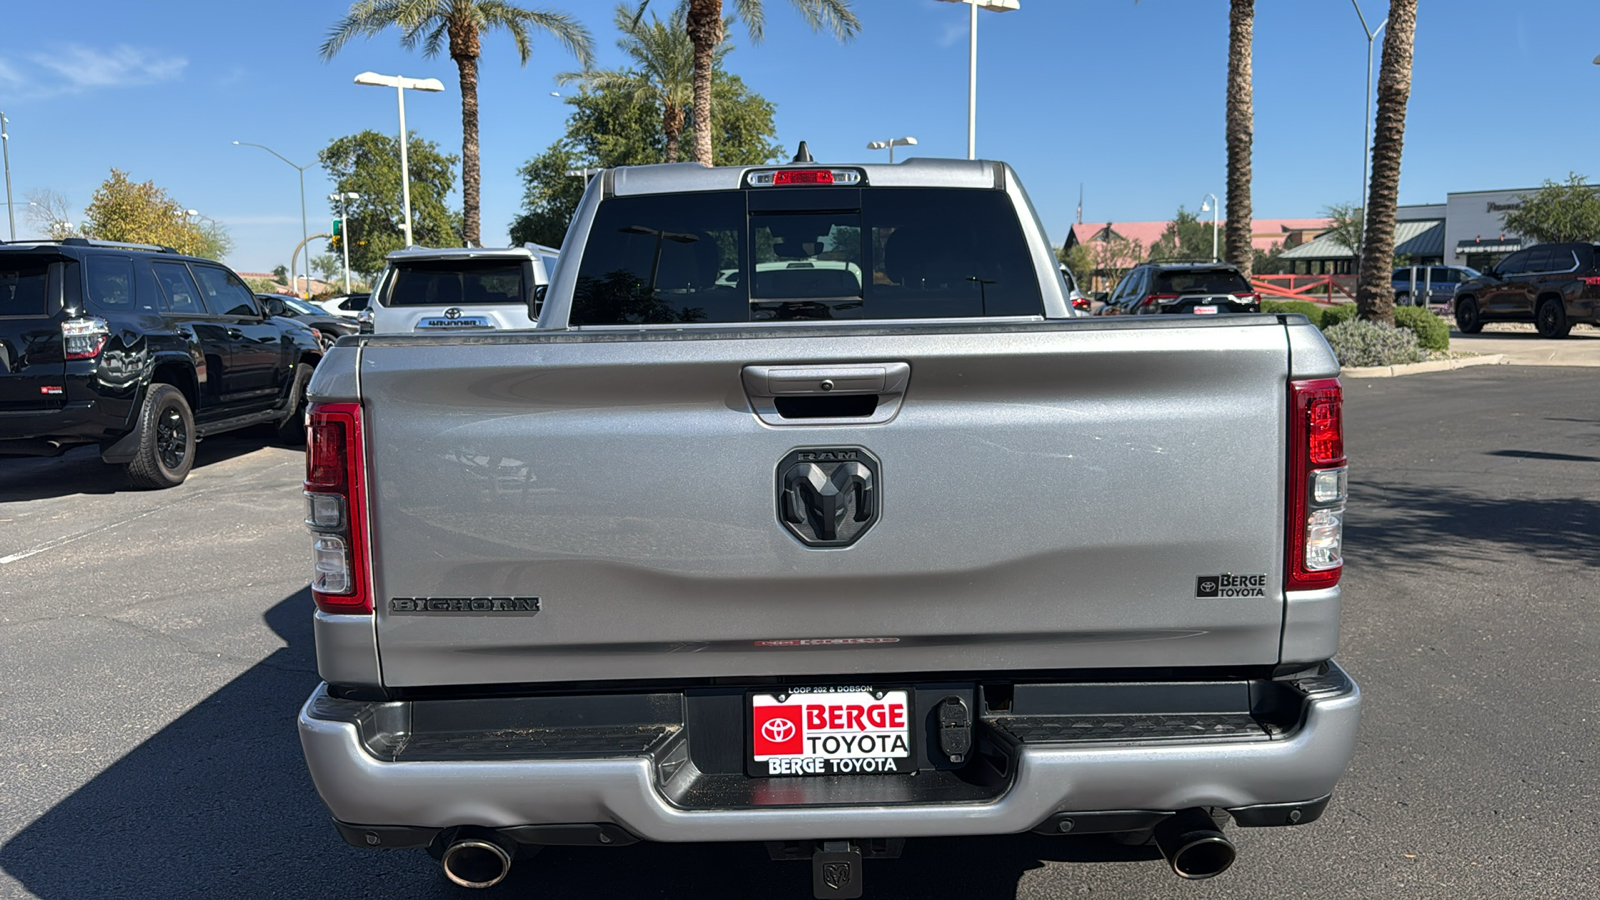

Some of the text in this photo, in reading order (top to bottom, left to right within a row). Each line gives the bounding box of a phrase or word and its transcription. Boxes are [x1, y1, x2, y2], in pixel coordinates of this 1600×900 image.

[797, 451, 858, 461] RAM
[1220, 574, 1266, 587] BERGE
[1219, 588, 1264, 597] TOYOTA
[391, 597, 541, 612] BIGHORN
[837, 685, 873, 693] DOBSON
[806, 704, 905, 731] BERGE
[806, 734, 909, 755] TOYOTA
[768, 757, 897, 775] BERGE TOYOTA
